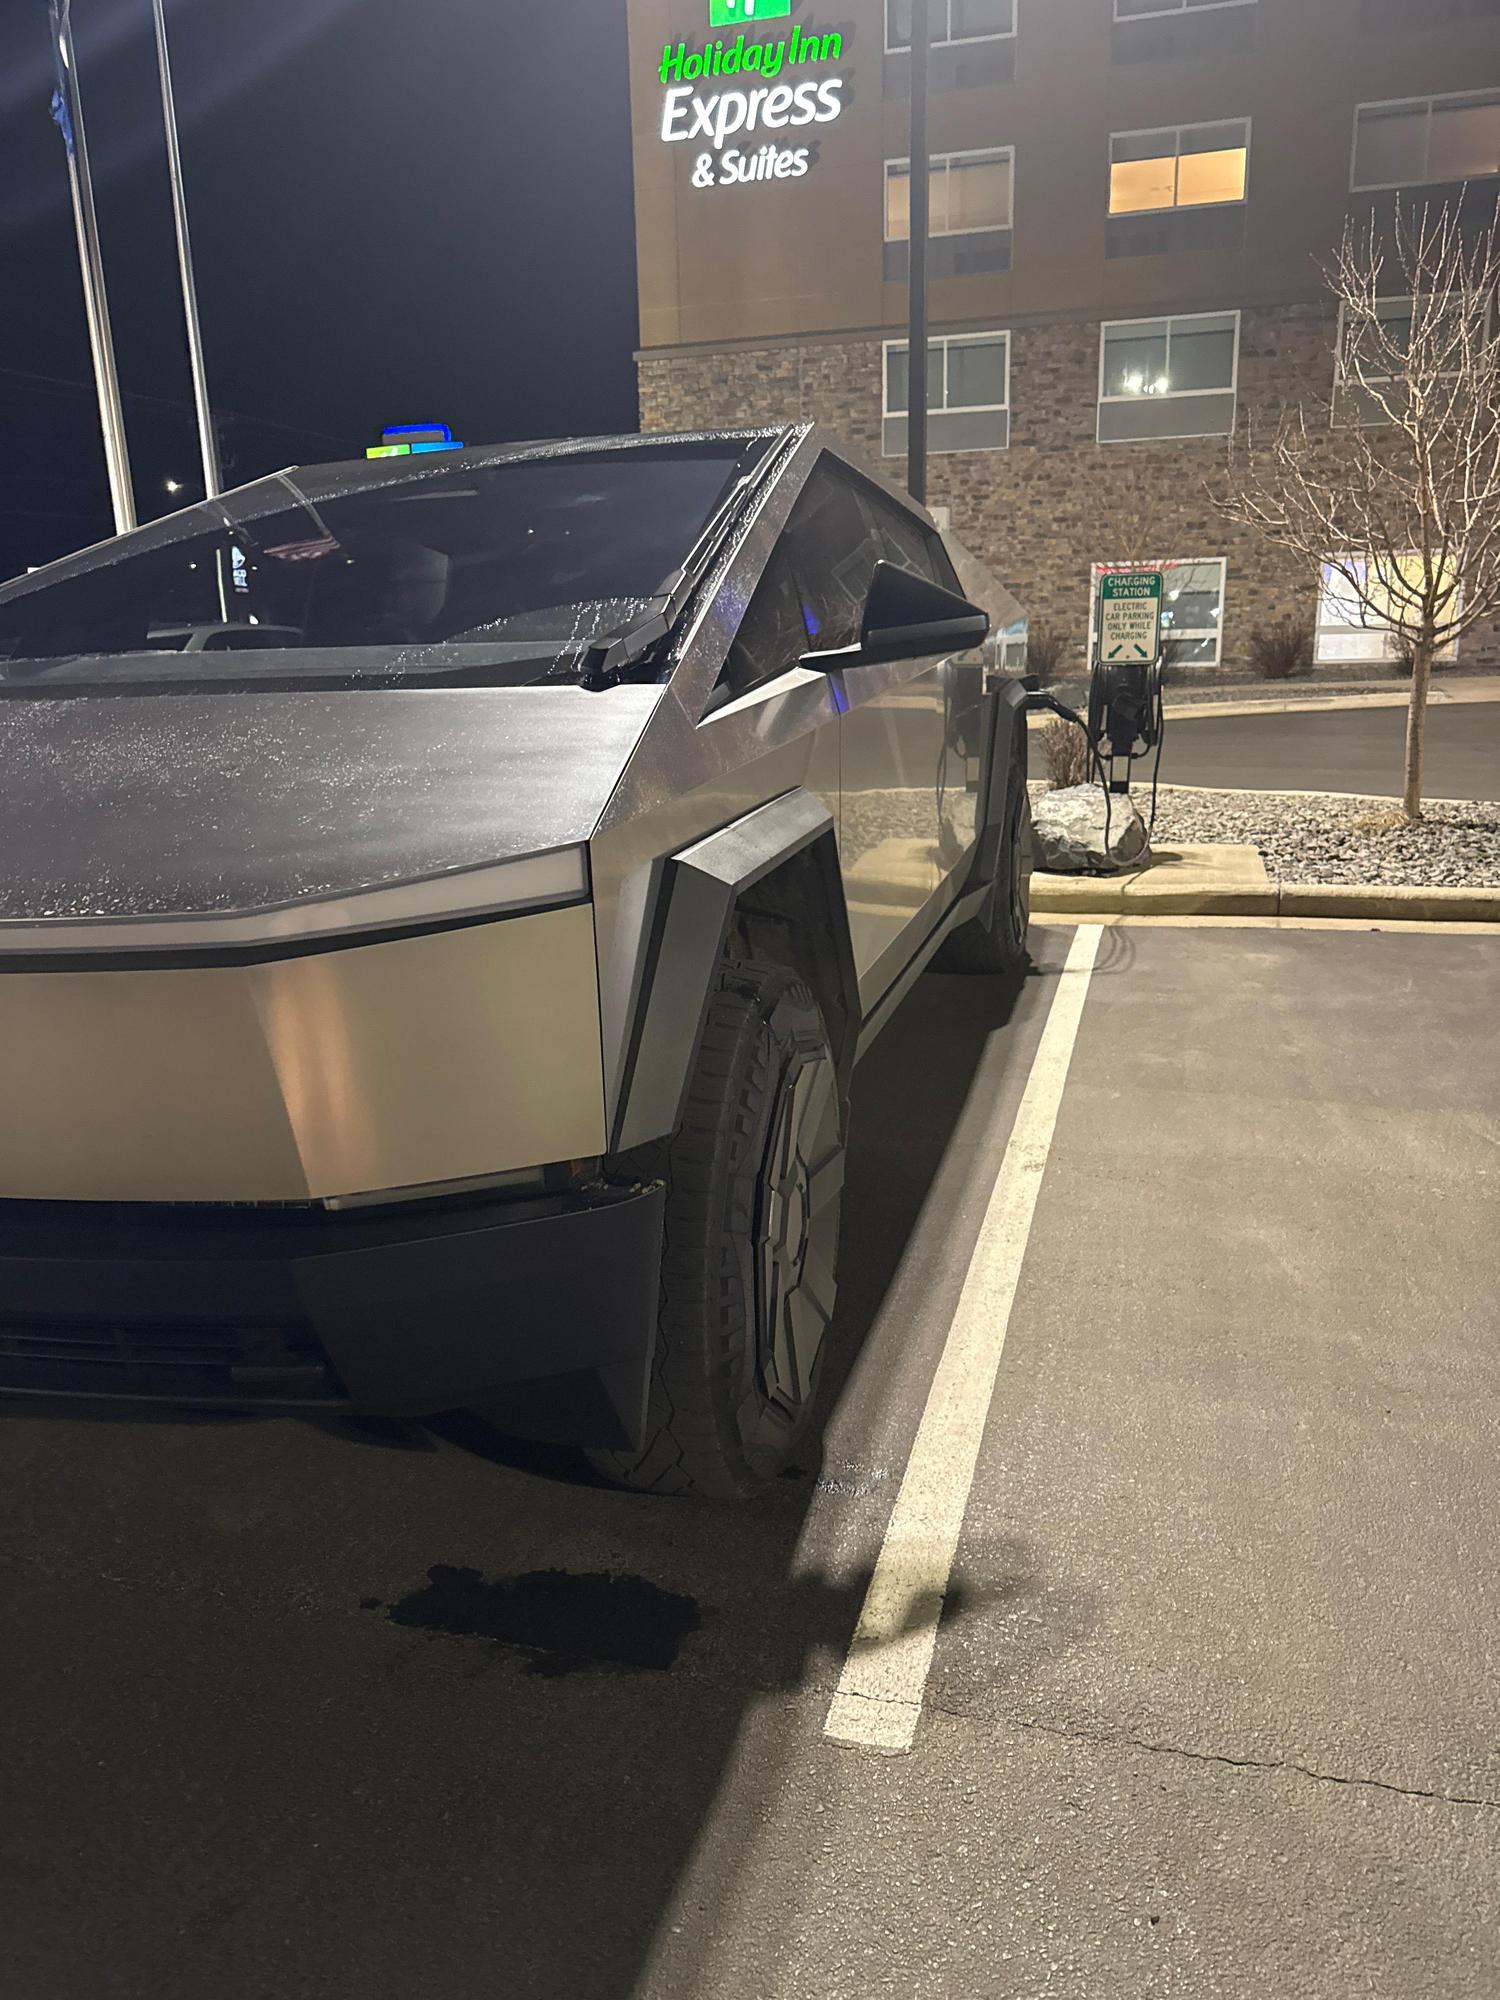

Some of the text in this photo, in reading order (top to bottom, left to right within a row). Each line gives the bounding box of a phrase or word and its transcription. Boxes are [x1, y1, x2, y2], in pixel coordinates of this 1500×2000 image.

[658, 25, 842, 84] Holiday Inn
[661, 79, 843, 149] Express
[692, 144, 809, 188] & Suites
[1107, 576, 1156, 587] CHARGING
[1112, 587, 1151, 597] STATION
[1113, 602, 1148, 611] ELECTRIC
[1105, 611, 1154, 621] CAR PARKING
[1107, 621, 1151, 630] ONLY WHILE
[1110, 631, 1148, 641] CHARGING
